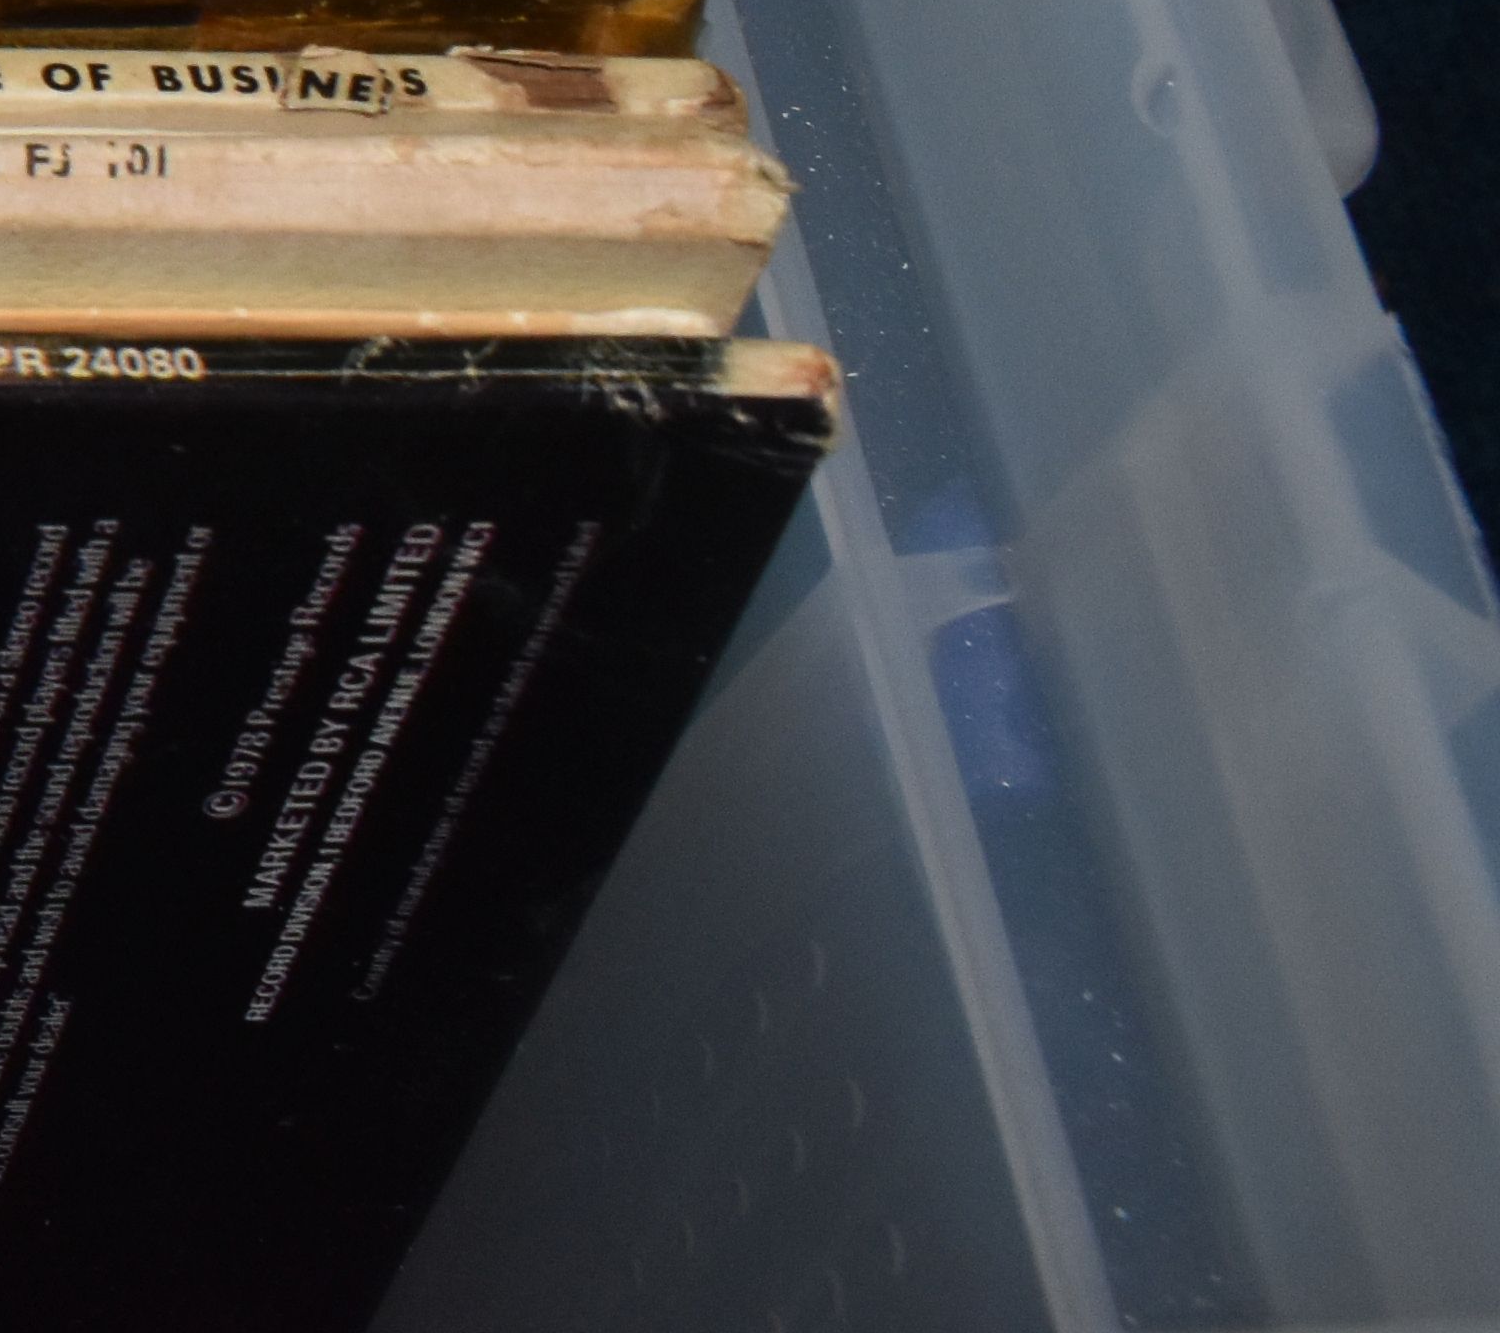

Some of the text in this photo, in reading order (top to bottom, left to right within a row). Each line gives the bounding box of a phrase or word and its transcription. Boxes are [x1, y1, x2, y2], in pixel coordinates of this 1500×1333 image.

[40, 60, 112, 90] OF
[63, 348, 205, 381] 24080
[23, 524, 69, 596] record
[223, 523, 363, 788] 1978 Prestige Records
[242, 522, 443, 908] MARKETED BY RCA LIMITED
[245, 521, 496, 1022] RECORD BEDFORD LONDON WC1
